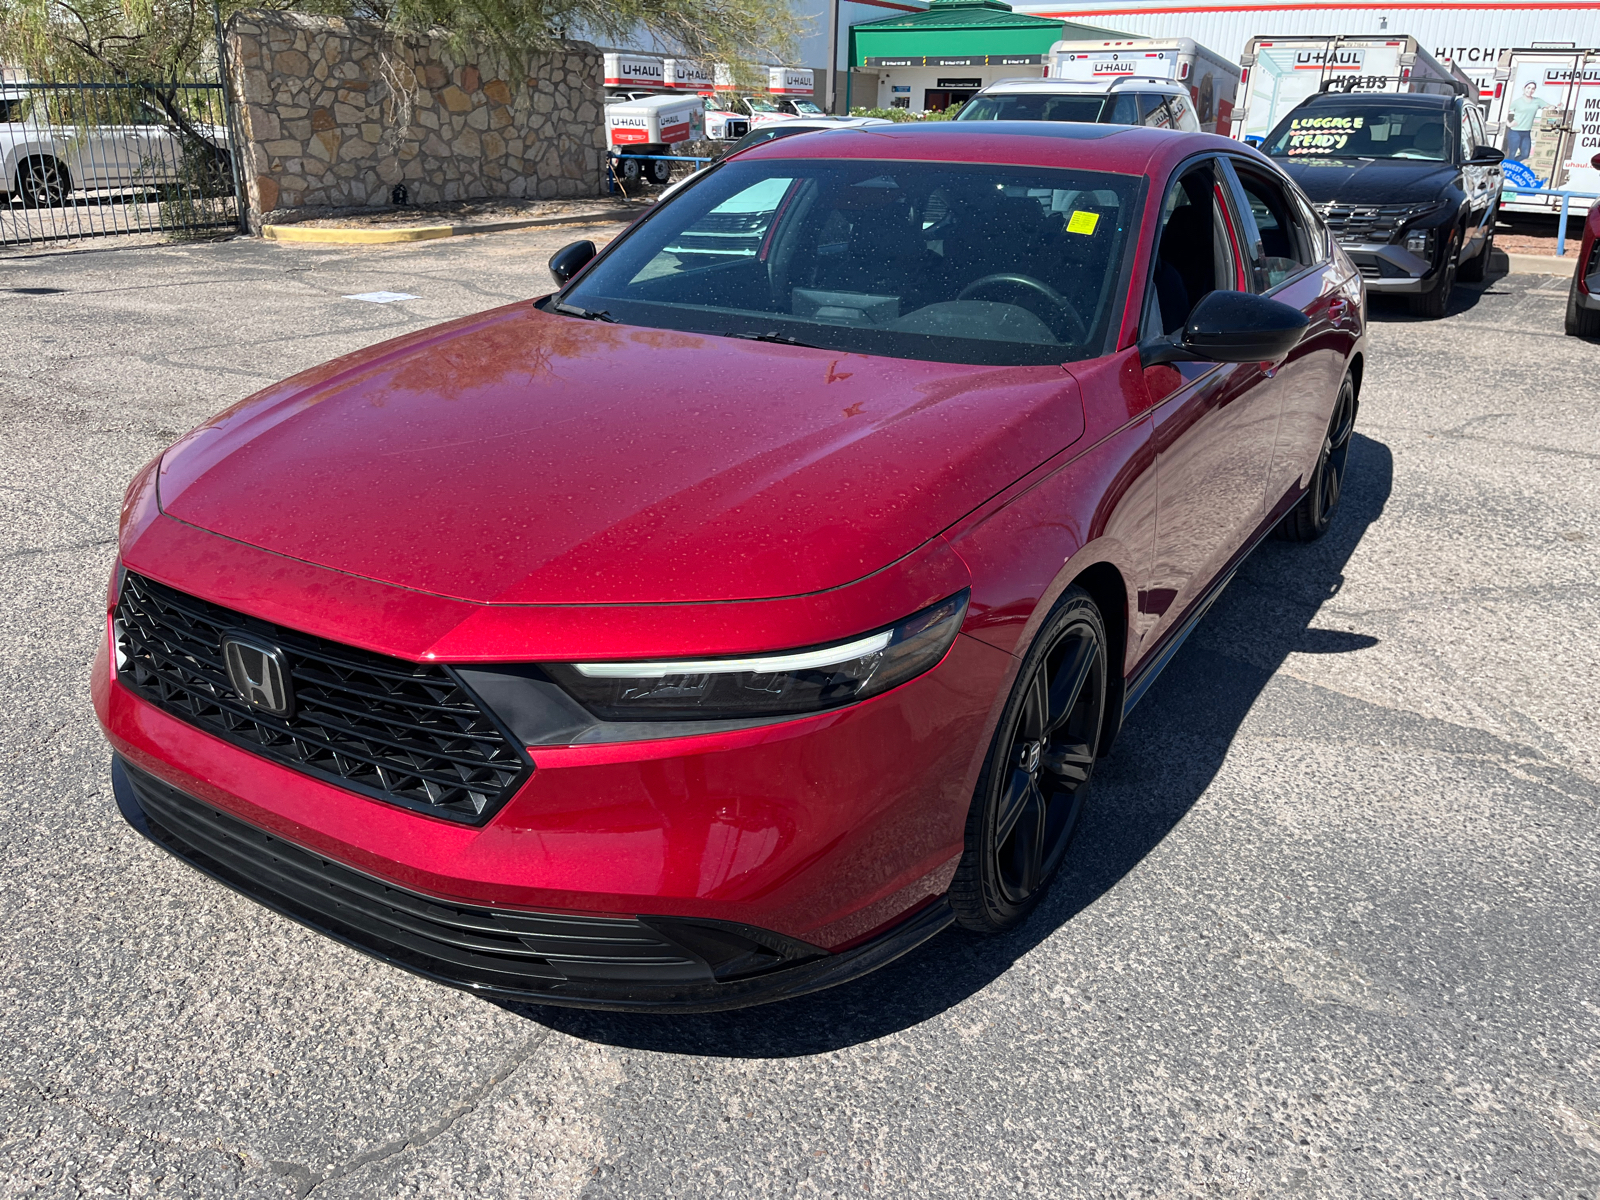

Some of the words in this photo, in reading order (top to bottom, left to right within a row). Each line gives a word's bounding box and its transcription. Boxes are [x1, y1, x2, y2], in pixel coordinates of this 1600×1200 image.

[1297, 52, 1361, 63] U-HAUL
[622, 64, 662, 77] U-HAUL
[1094, 63, 1134, 72] U-HAUL
[677, 69, 713, 81] U-HAU
[787, 76, 813, 86] U-HAUL
[611, 118, 647, 127] U-HAUL
[660, 115, 680, 126] U-HAUL
[1291, 117, 1364, 129] LUGGAGE
[1289, 134, 1348, 149] READY
[1501, 161, 1523, 173] OWEST
[1522, 170, 1537, 188] DECKS
